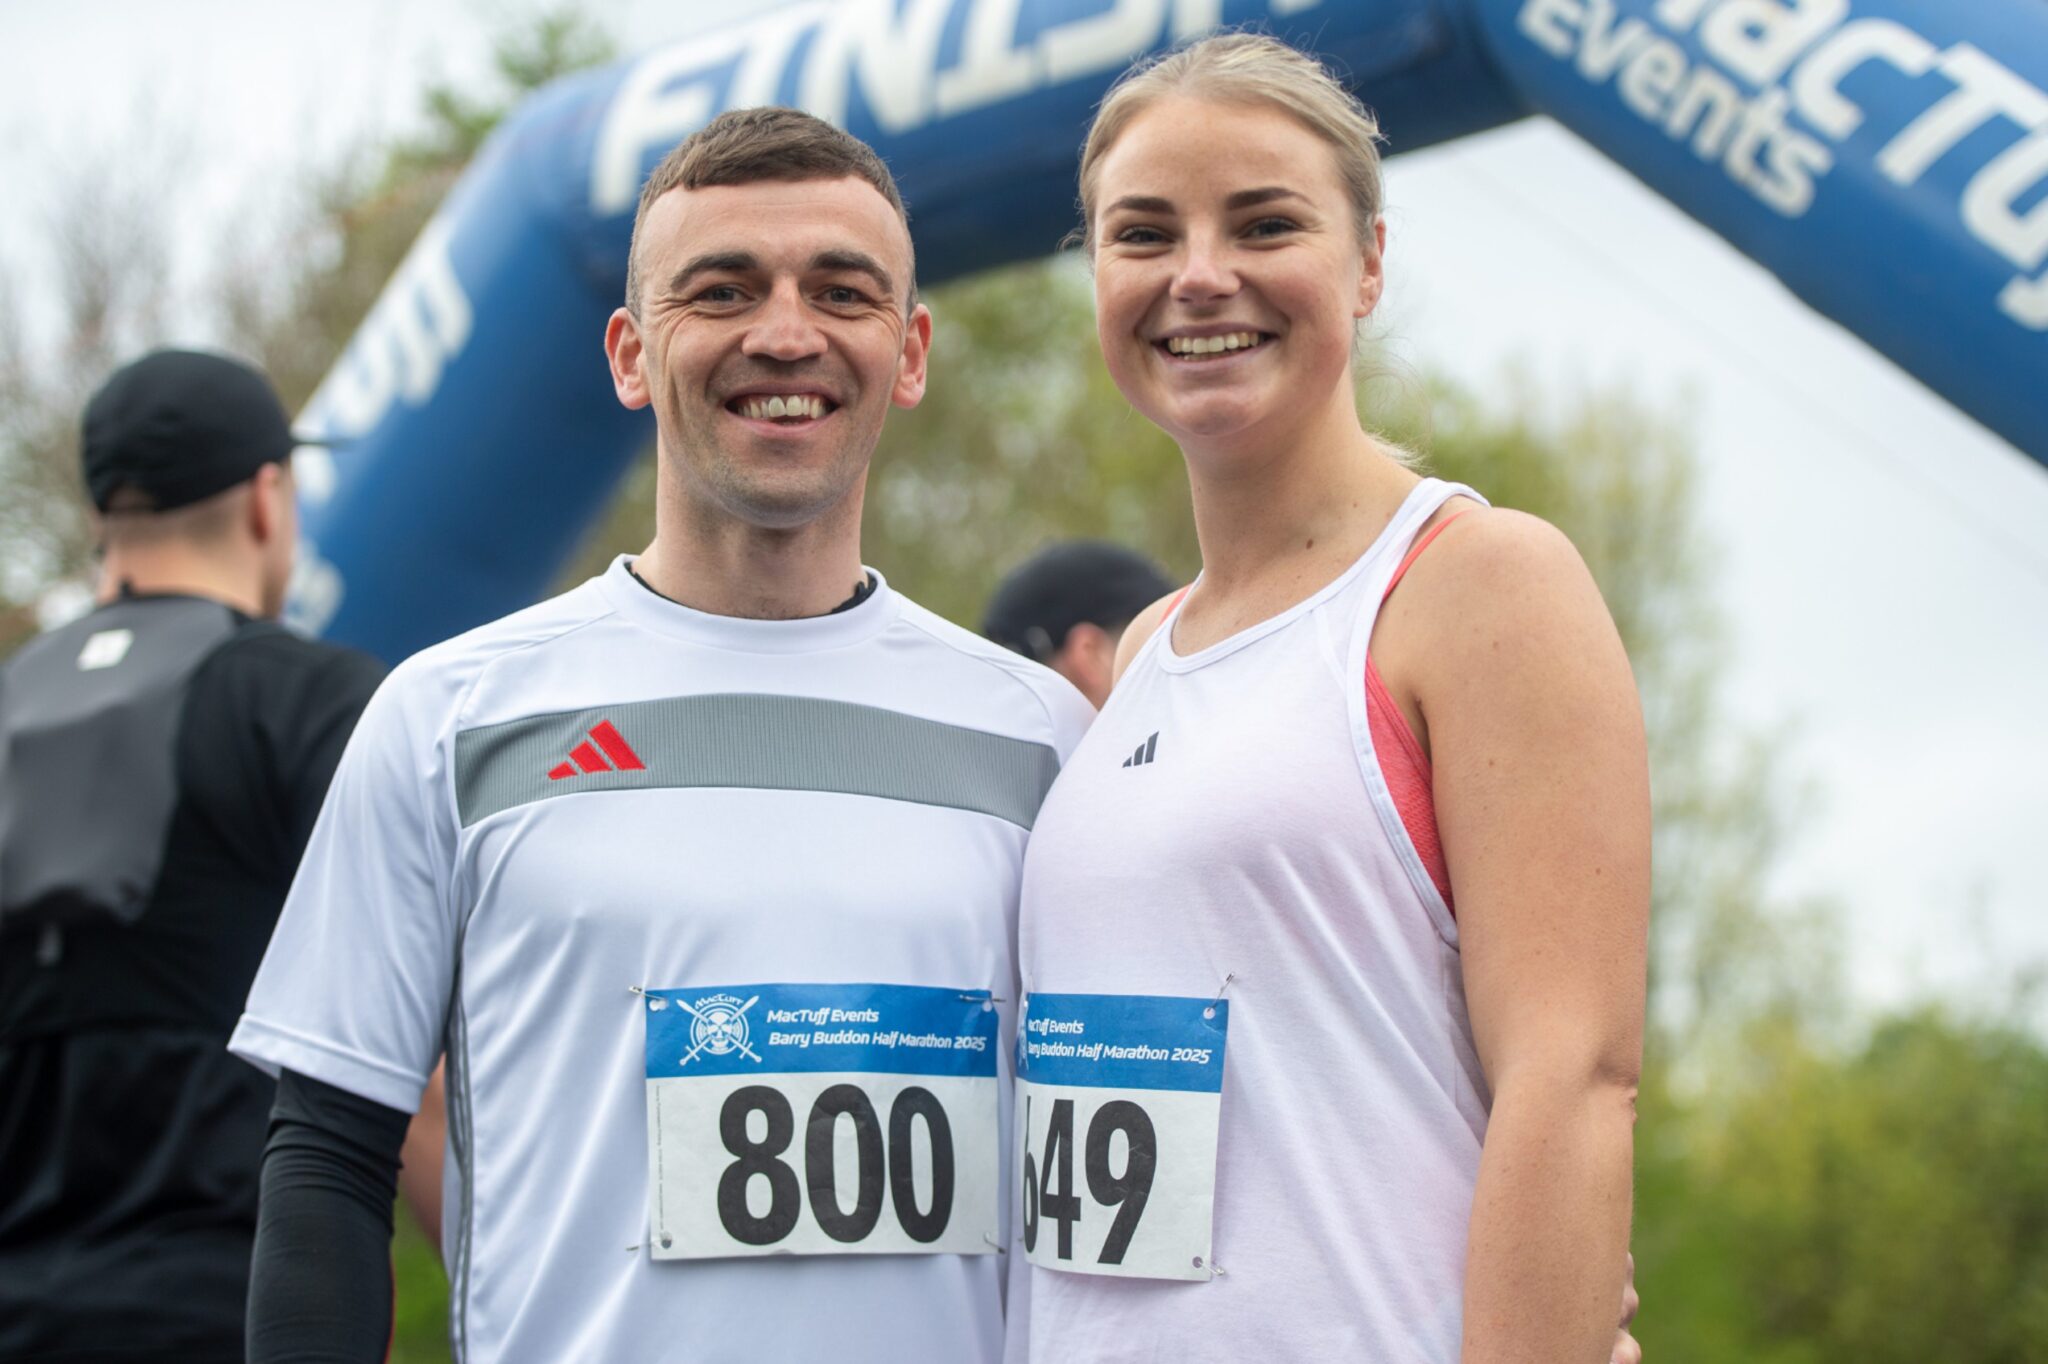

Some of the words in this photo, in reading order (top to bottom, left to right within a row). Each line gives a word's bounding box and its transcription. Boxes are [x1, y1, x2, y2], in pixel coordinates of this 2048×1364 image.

[590, 0, 1328, 218] FINI
[1517, 0, 1834, 218] events
[767, 1008, 830, 1026] MacTuff
[830, 1008, 880, 1023] Events
[768, 1031, 811, 1048] Barry
[813, 1029, 870, 1045] Buddon
[872, 1031, 899, 1049] Half
[898, 1033, 953, 1049] Marathon
[953, 1035, 987, 1052] 2025
[1041, 1042, 1076, 1057] Buddon
[1076, 1043, 1103, 1062] Half
[1103, 1044, 1170, 1061] Marathon
[1171, 1047, 1213, 1065] 2025
[1049, 1020, 1085, 1034] Events
[717, 1083, 955, 1246] 800
[1023, 1095, 1157, 1265] 649
